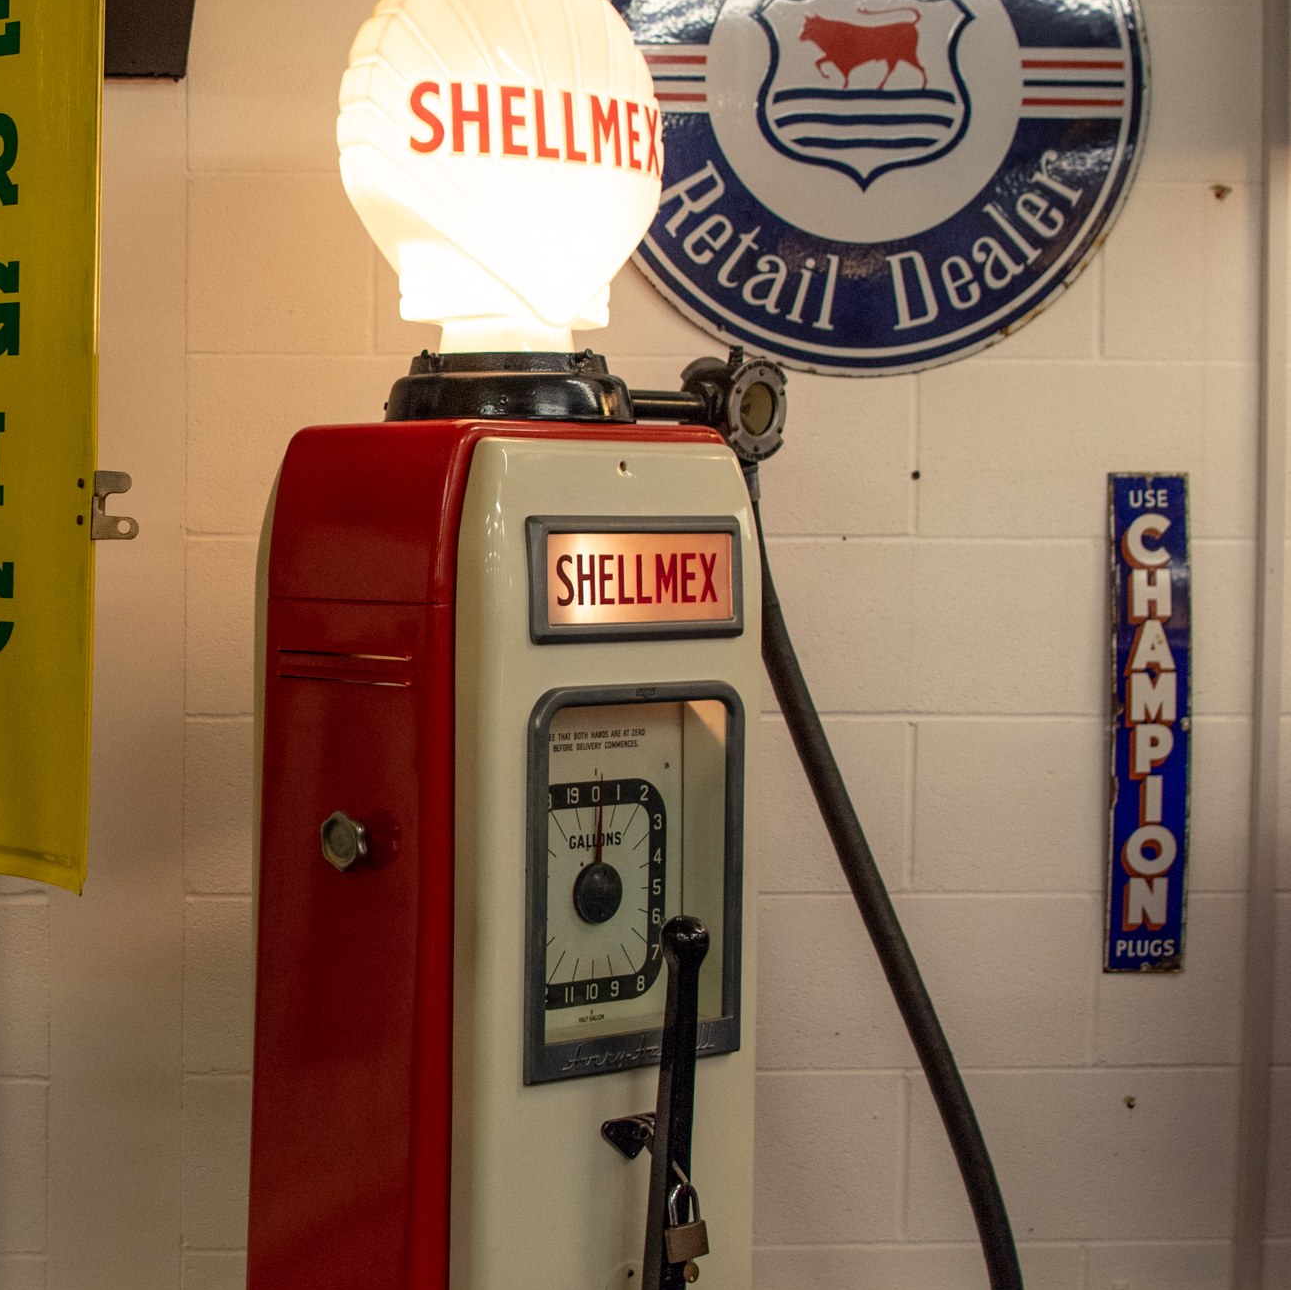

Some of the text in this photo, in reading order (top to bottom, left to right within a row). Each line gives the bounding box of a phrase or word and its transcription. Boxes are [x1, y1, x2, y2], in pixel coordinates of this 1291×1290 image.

[409, 80, 662, 177] SHELLMEX
[657, 148, 1084, 331] Retail Dealer
[1128, 488, 1169, 509] USE
[556, 552, 718, 607] SHELLMEX
[1121, 512, 1178, 932] CHAMPION
[558, 732, 571, 741] THAT
[573, 731, 588, 740] BOTH
[590, 729, 608, 739] HANDS
[610, 729, 621, 738] ARE
[623, 729, 630, 737] AT
[631, 728, 646, 737] ZERO
[553, 739, 640, 753] BEFORE DELIVERY COMMENCES.
[567, 787, 580, 804] 19
[591, 785, 600, 802] 0
[616, 784, 620, 801] 1
[640, 784, 649, 801] 2
[653, 813, 662, 830] 3
[568, 831, 622, 850] GALLONS
[653, 847, 662, 864] 4
[652, 878, 661, 895] 5
[652, 907, 661, 924] 6
[651, 943, 660, 961] 7
[1115, 938, 1175, 958] PLUGS
[565, 986, 574, 1004] 11
[586, 982, 598, 1000] 10
[610, 980, 619, 997] 9
[636, 974, 645, 992] 8
[578, 1013, 605, 1024] HALF GALLON
